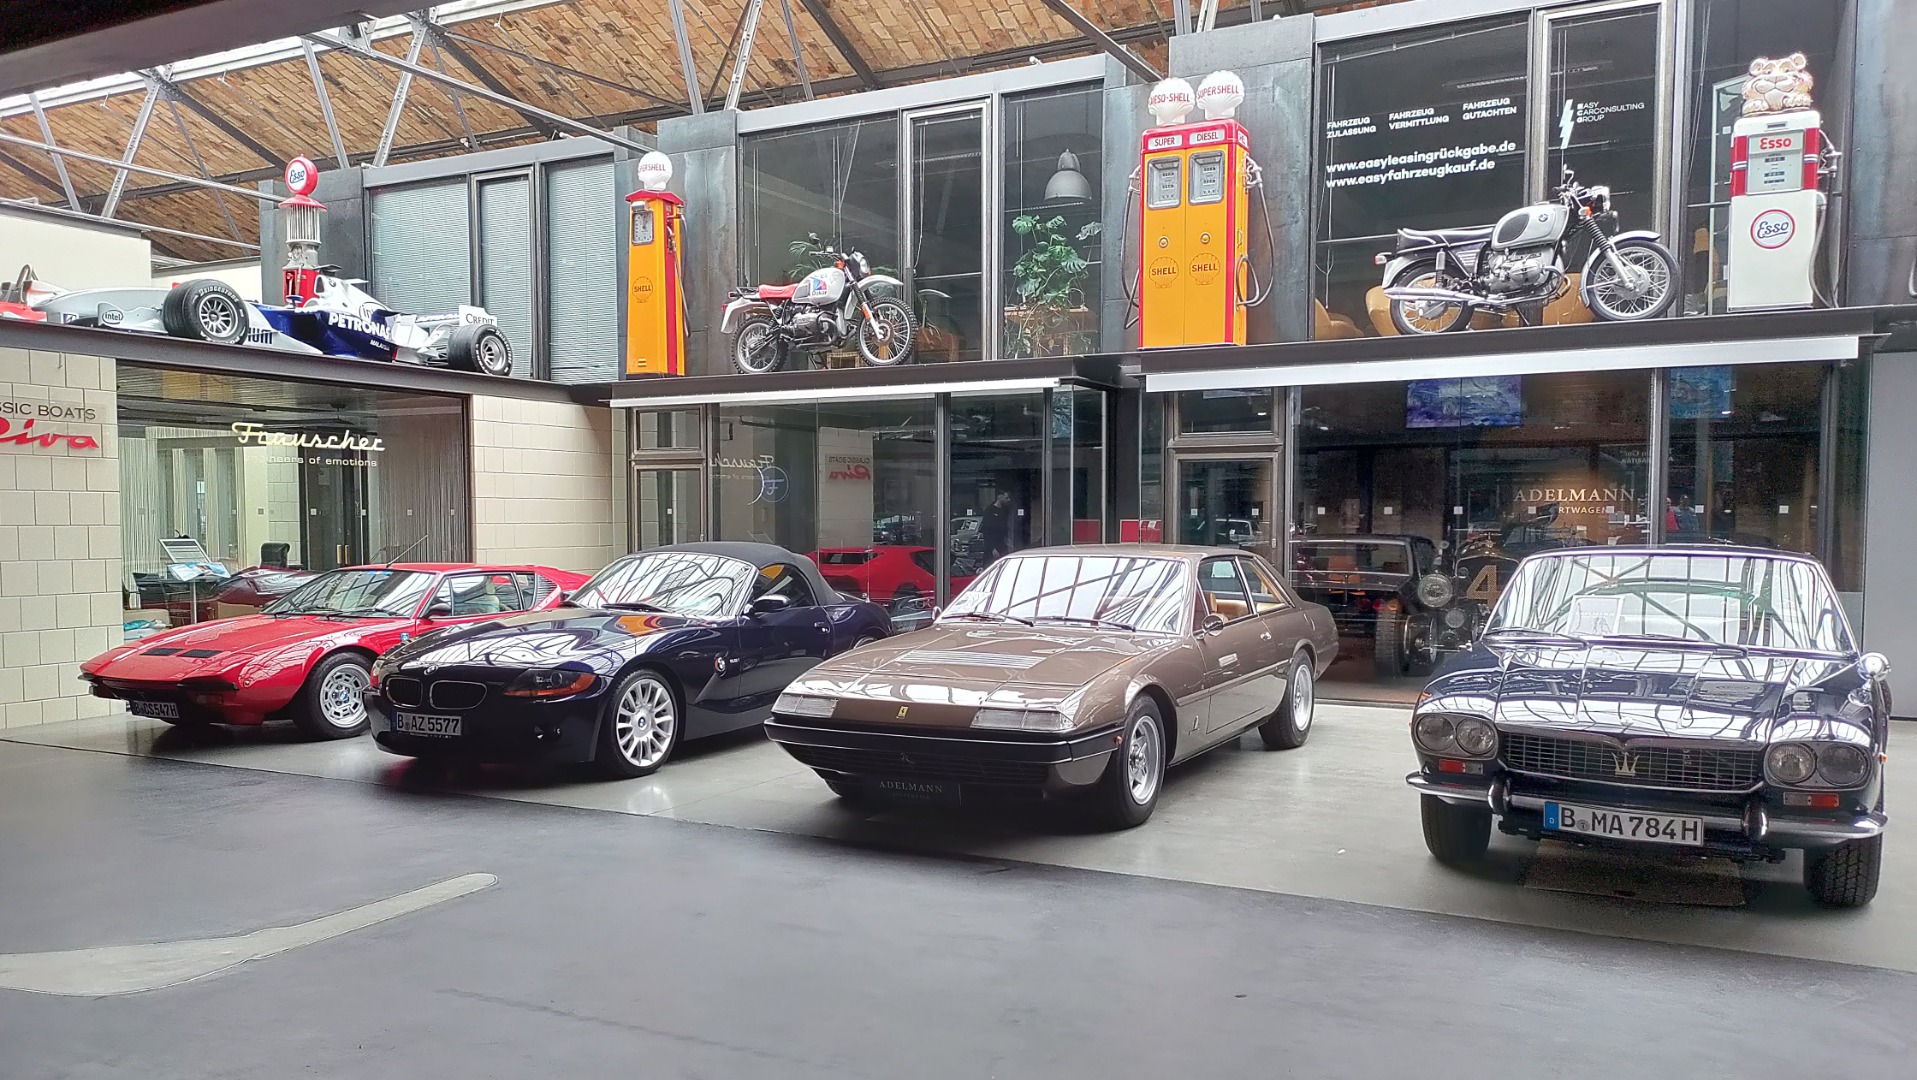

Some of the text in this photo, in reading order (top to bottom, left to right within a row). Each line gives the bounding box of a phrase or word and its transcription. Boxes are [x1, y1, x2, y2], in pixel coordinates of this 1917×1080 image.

[1463, 97, 1510, 111] FAHRZEUG
[1577, 101, 1599, 110] EASY
[1577, 102, 1645, 116] CARCONSULTING
[1389, 107, 1434, 121] FAHRZEUG
[1463, 106, 1517, 120] GUTACHTEN
[1576, 115, 1605, 123] GROUP
[1326, 116, 1371, 129] FAHRZEUG
[1389, 115, 1450, 130] VERMITTLUNG
[1196, 131, 1218, 141] DIESEL
[1326, 125, 1377, 139] ZULASSUNG
[1154, 137, 1175, 147] SUPER
[1326, 140, 1516, 174] www.easyleasingrückgabe.de
[290, 169, 305, 184] Esso
[1326, 158, 1496, 188] www.easyfahrzeugkauf.de
[1757, 221, 1789, 239] Esso
[1151, 267, 1177, 276] SHELL
[1191, 263, 1218, 272] SHELL
[104, 311, 122, 321] intel
[328, 313, 392, 341] PETRONAS
[38, 404, 96, 419] BOATS
[231, 421, 385, 451] Frauscher
[308, 456, 321, 465] of
[325, 457, 377, 467] emotions
[1514, 488, 1635, 502] ADELMANN
[397, 714, 459, 733] B AZ 5577
[880, 780, 942, 793] ADELMANN
[1560, 806, 1576, 828] B
